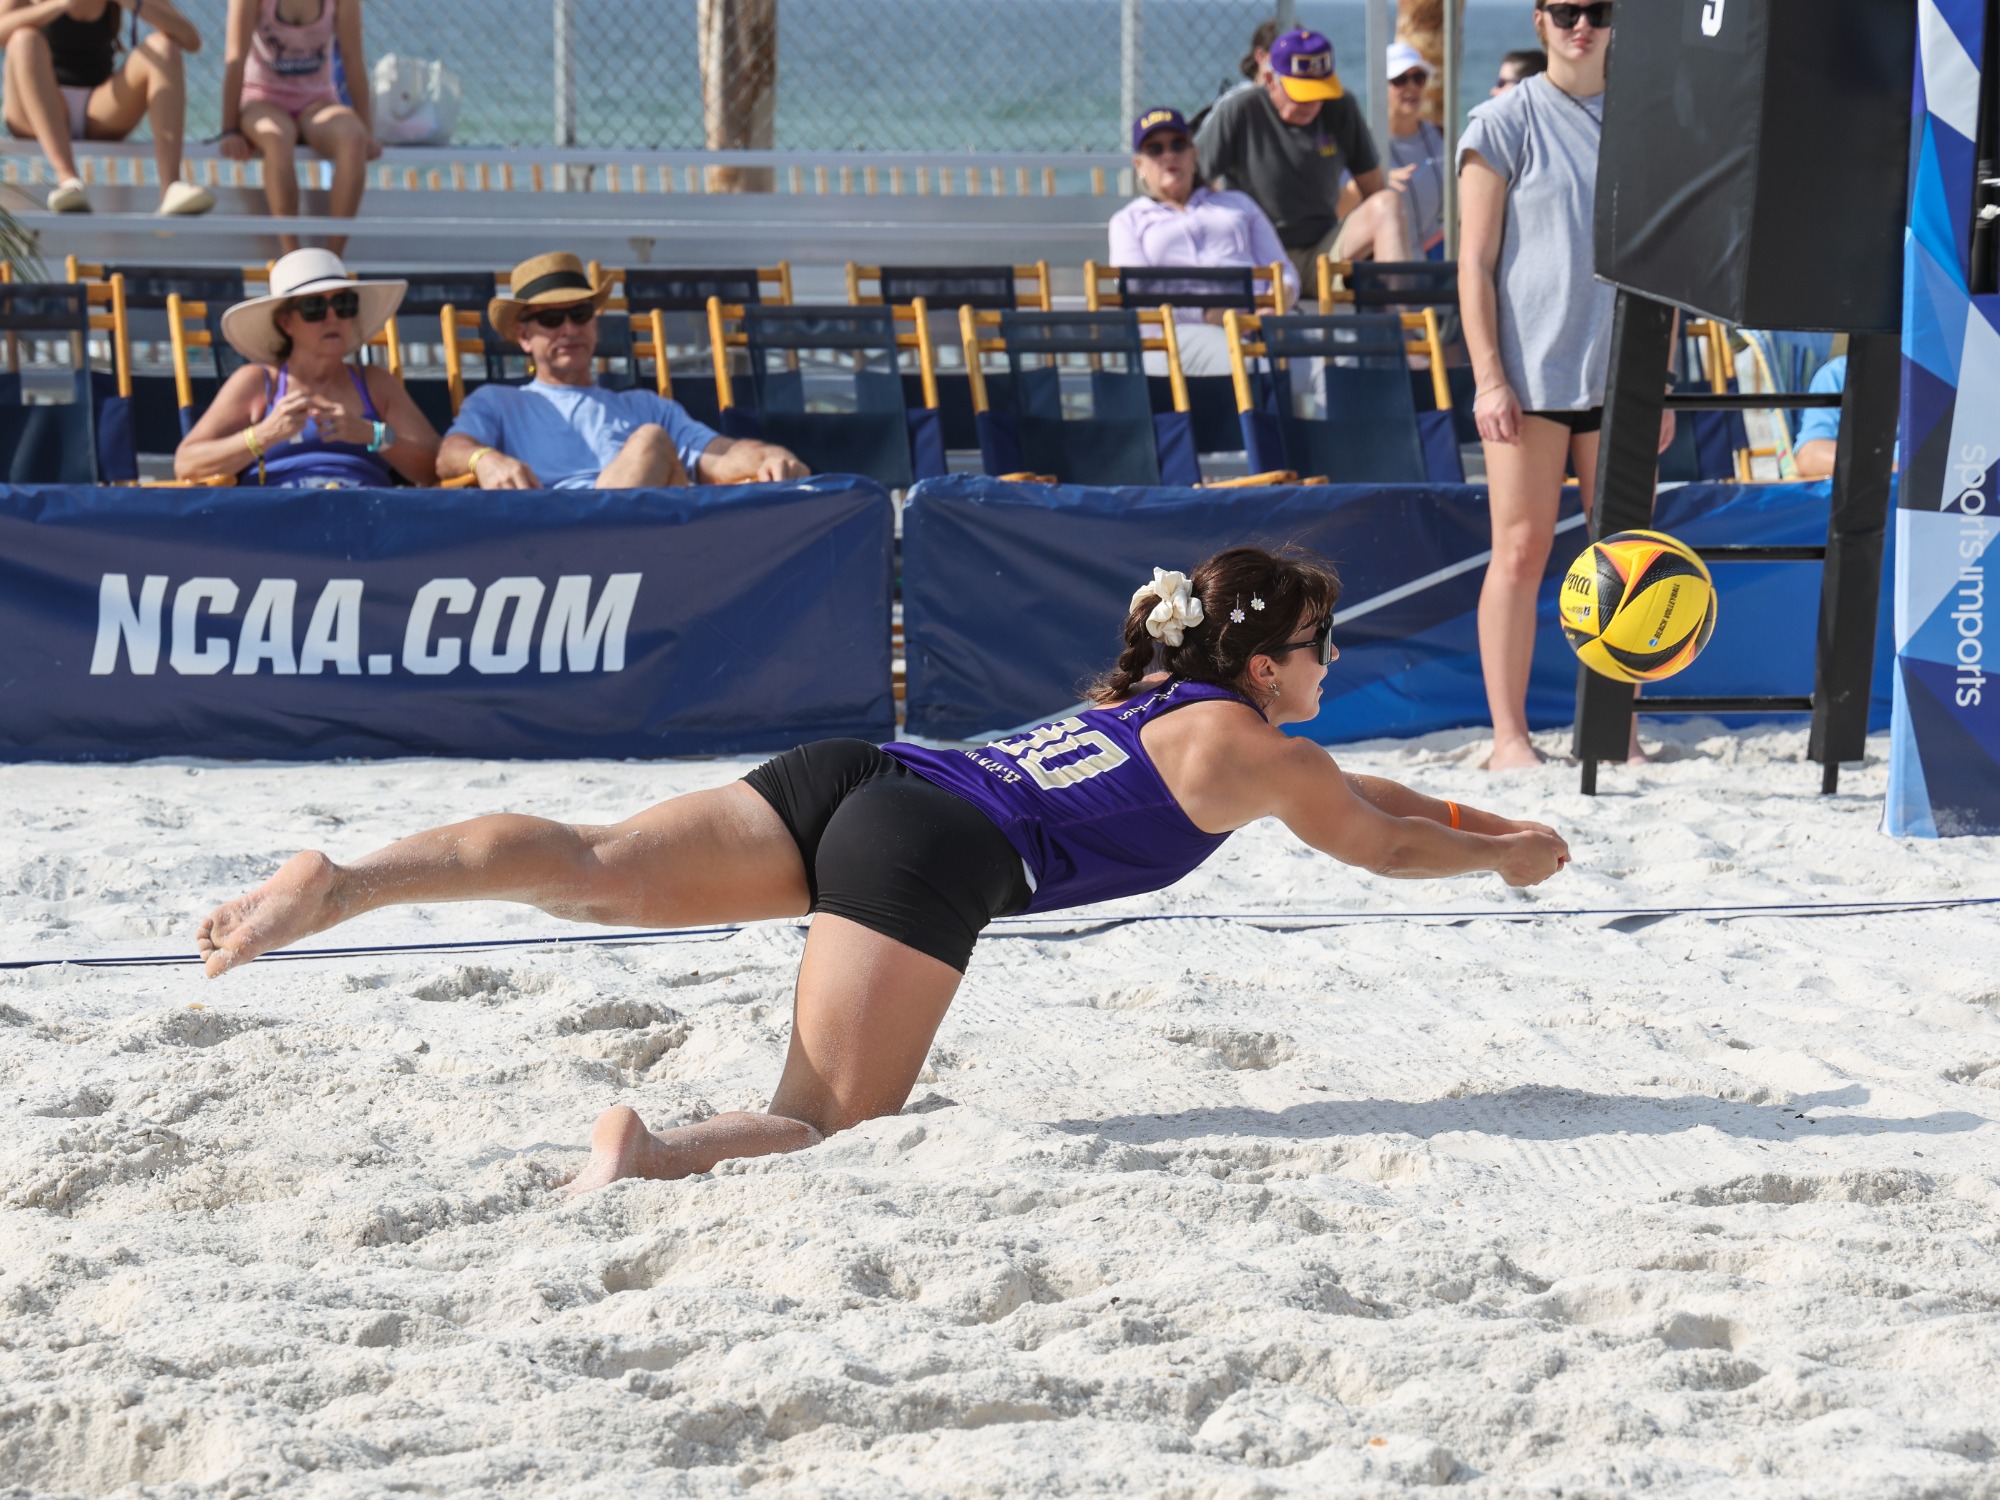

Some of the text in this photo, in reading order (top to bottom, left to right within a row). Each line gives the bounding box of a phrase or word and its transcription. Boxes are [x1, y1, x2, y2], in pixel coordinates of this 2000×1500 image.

[1953, 444, 1989, 559] sports
[90, 572, 643, 675] NCAA.COM
[1654, 583, 1680, 639] BEACH VOLLEYBALL
